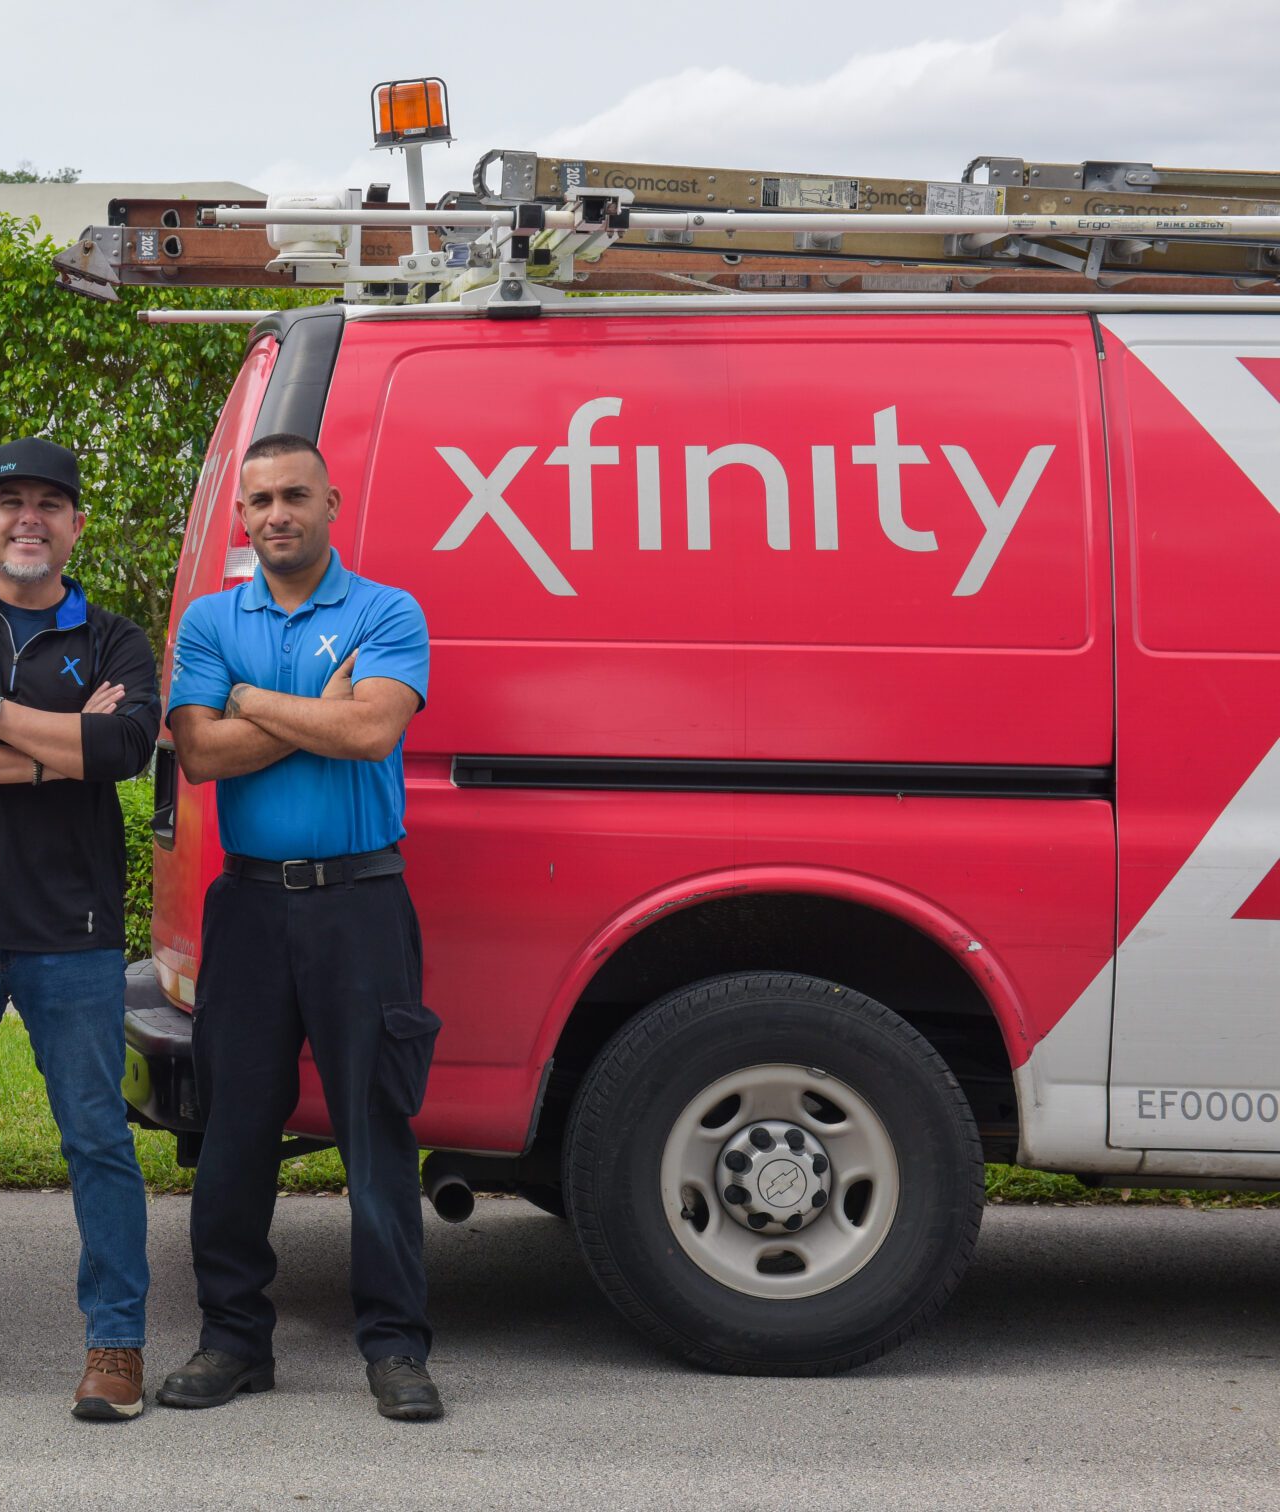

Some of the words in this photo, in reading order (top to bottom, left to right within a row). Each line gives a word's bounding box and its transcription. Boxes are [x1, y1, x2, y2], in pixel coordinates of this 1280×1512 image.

[566, 167, 580, 188] 202
[141, 235, 154, 256] 2024
[432, 397, 1057, 596] xfinity
